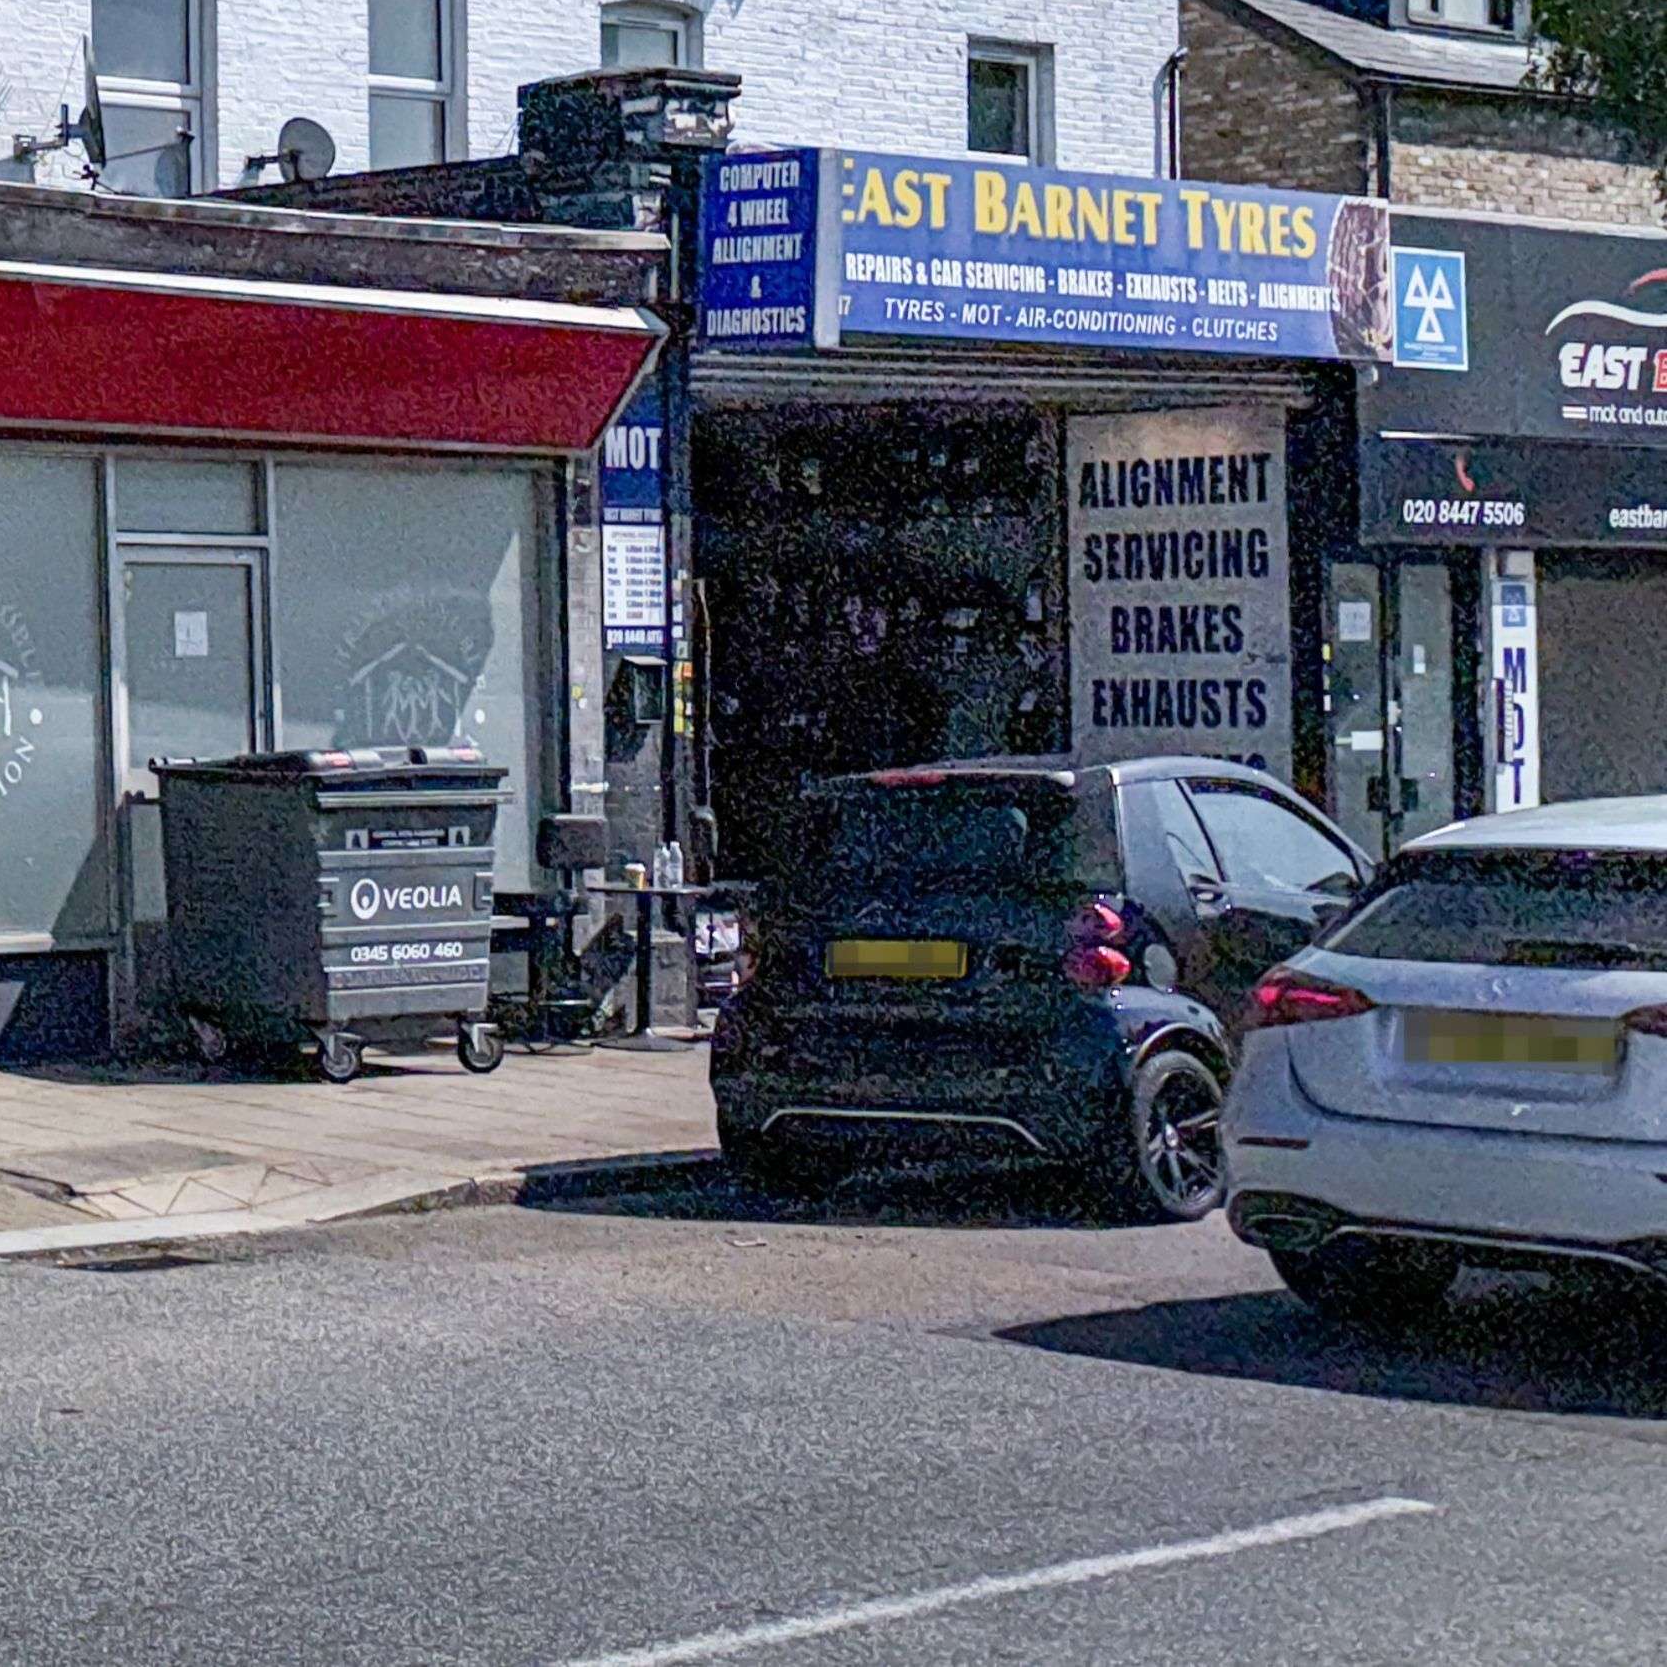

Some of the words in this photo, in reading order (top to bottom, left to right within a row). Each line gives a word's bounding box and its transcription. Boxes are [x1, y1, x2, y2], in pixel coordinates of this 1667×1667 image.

[720, 161, 799, 193] COMPUTER
[727, 203, 737, 228] 4
[740, 198, 789, 226] WHEEL
[974, 170, 1162, 246] BARNET
[1179, 189, 1317, 260] TYRES
[713, 234, 804, 264] ALLIGNMENT
[750, 275, 762, 299] &
[845, 252, 913, 285] REPAIRS
[916, 262, 928, 285] &
[931, 258, 963, 288] CAR
[966, 260, 1046, 294] SERVICING
[1057, 267, 1113, 298] BRAKES
[1126, 271, 1198, 304] EXHAUSTS
[1208, 278, 1248, 308] BELTS
[1258, 283, 1342, 312] ALIGNMENTS
[708, 305, 806, 336] DIAGNOSTICS
[884, 296, 945, 323] TYRES
[961, 303, 1002, 326] MOT
[1015, 306, 1176, 335] AIR-CONDITIONING
[1192, 317, 1278, 342] CLUTCHES
[1559, 342, 1648, 391] EAST
[1589, 404, 1618, 423] mot
[605, 425, 663, 470] MOT
[1079, 452, 1271, 509] ALIGNMENT
[1403, 499, 1436, 524] 020
[1439, 500, 1481, 525] 8447
[1483, 501, 1525, 526] 5506
[1084, 528, 1270, 583] SERVICING
[1111, 604, 1244, 654] BRAKES
[1092, 678, 1267, 729] EXHAUSTS
[383, 884, 463, 910] VEOLIA
[351, 944, 388, 963] 0345
[391, 943, 430, 961] 6060
[434, 941, 463, 959] 460
